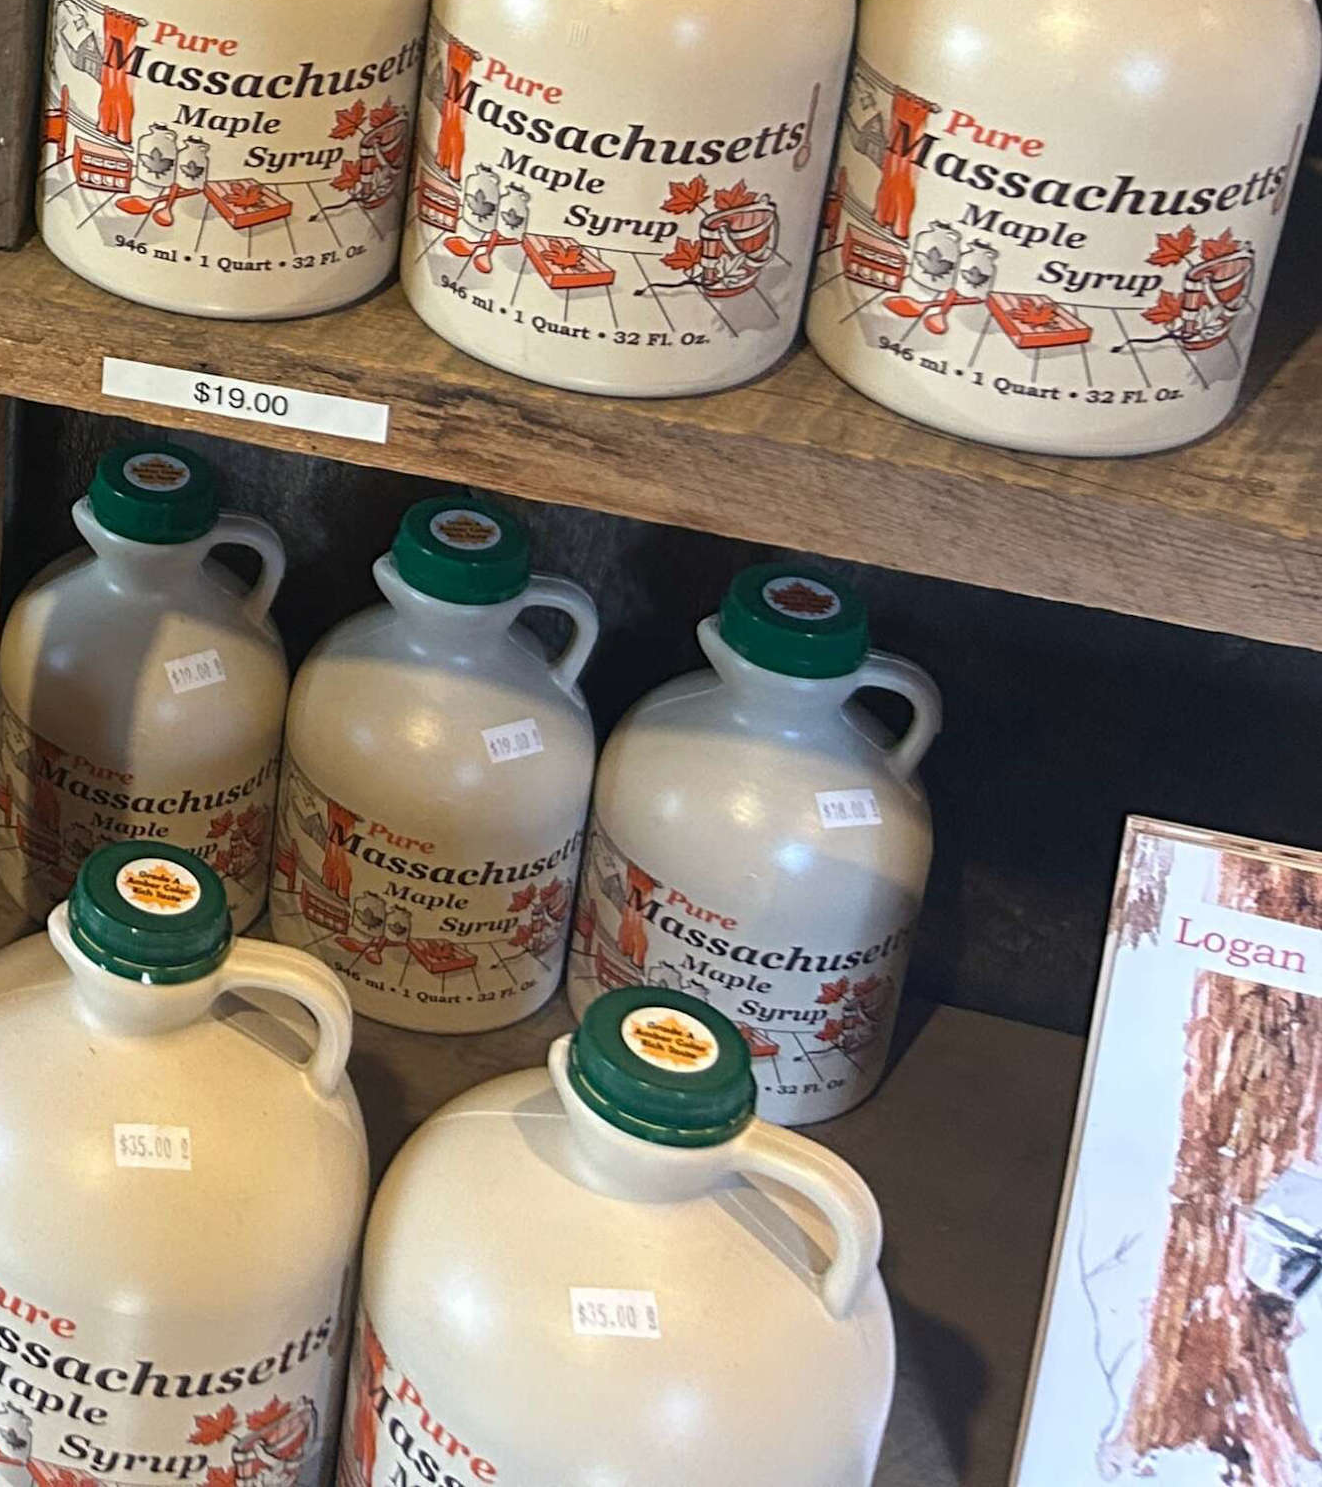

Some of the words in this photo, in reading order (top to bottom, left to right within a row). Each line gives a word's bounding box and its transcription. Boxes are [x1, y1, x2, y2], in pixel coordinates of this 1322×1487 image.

[482, 58, 563, 105] Pure
[446, 69, 806, 165] Massachusetts
[497, 147, 605, 194] Maple
[564, 205, 678, 242] Syrup
[440, 275, 467, 299] 946
[472, 294, 494, 314] ml
[532, 315, 590, 340] Quart
[613, 331, 640, 345] 32
[193, 381, 289, 417] $19.00
[1175, 915, 1307, 975] Logan
[119, 1134, 173, 1158] $35.00
[59, 1434, 208, 1479] Syrup
